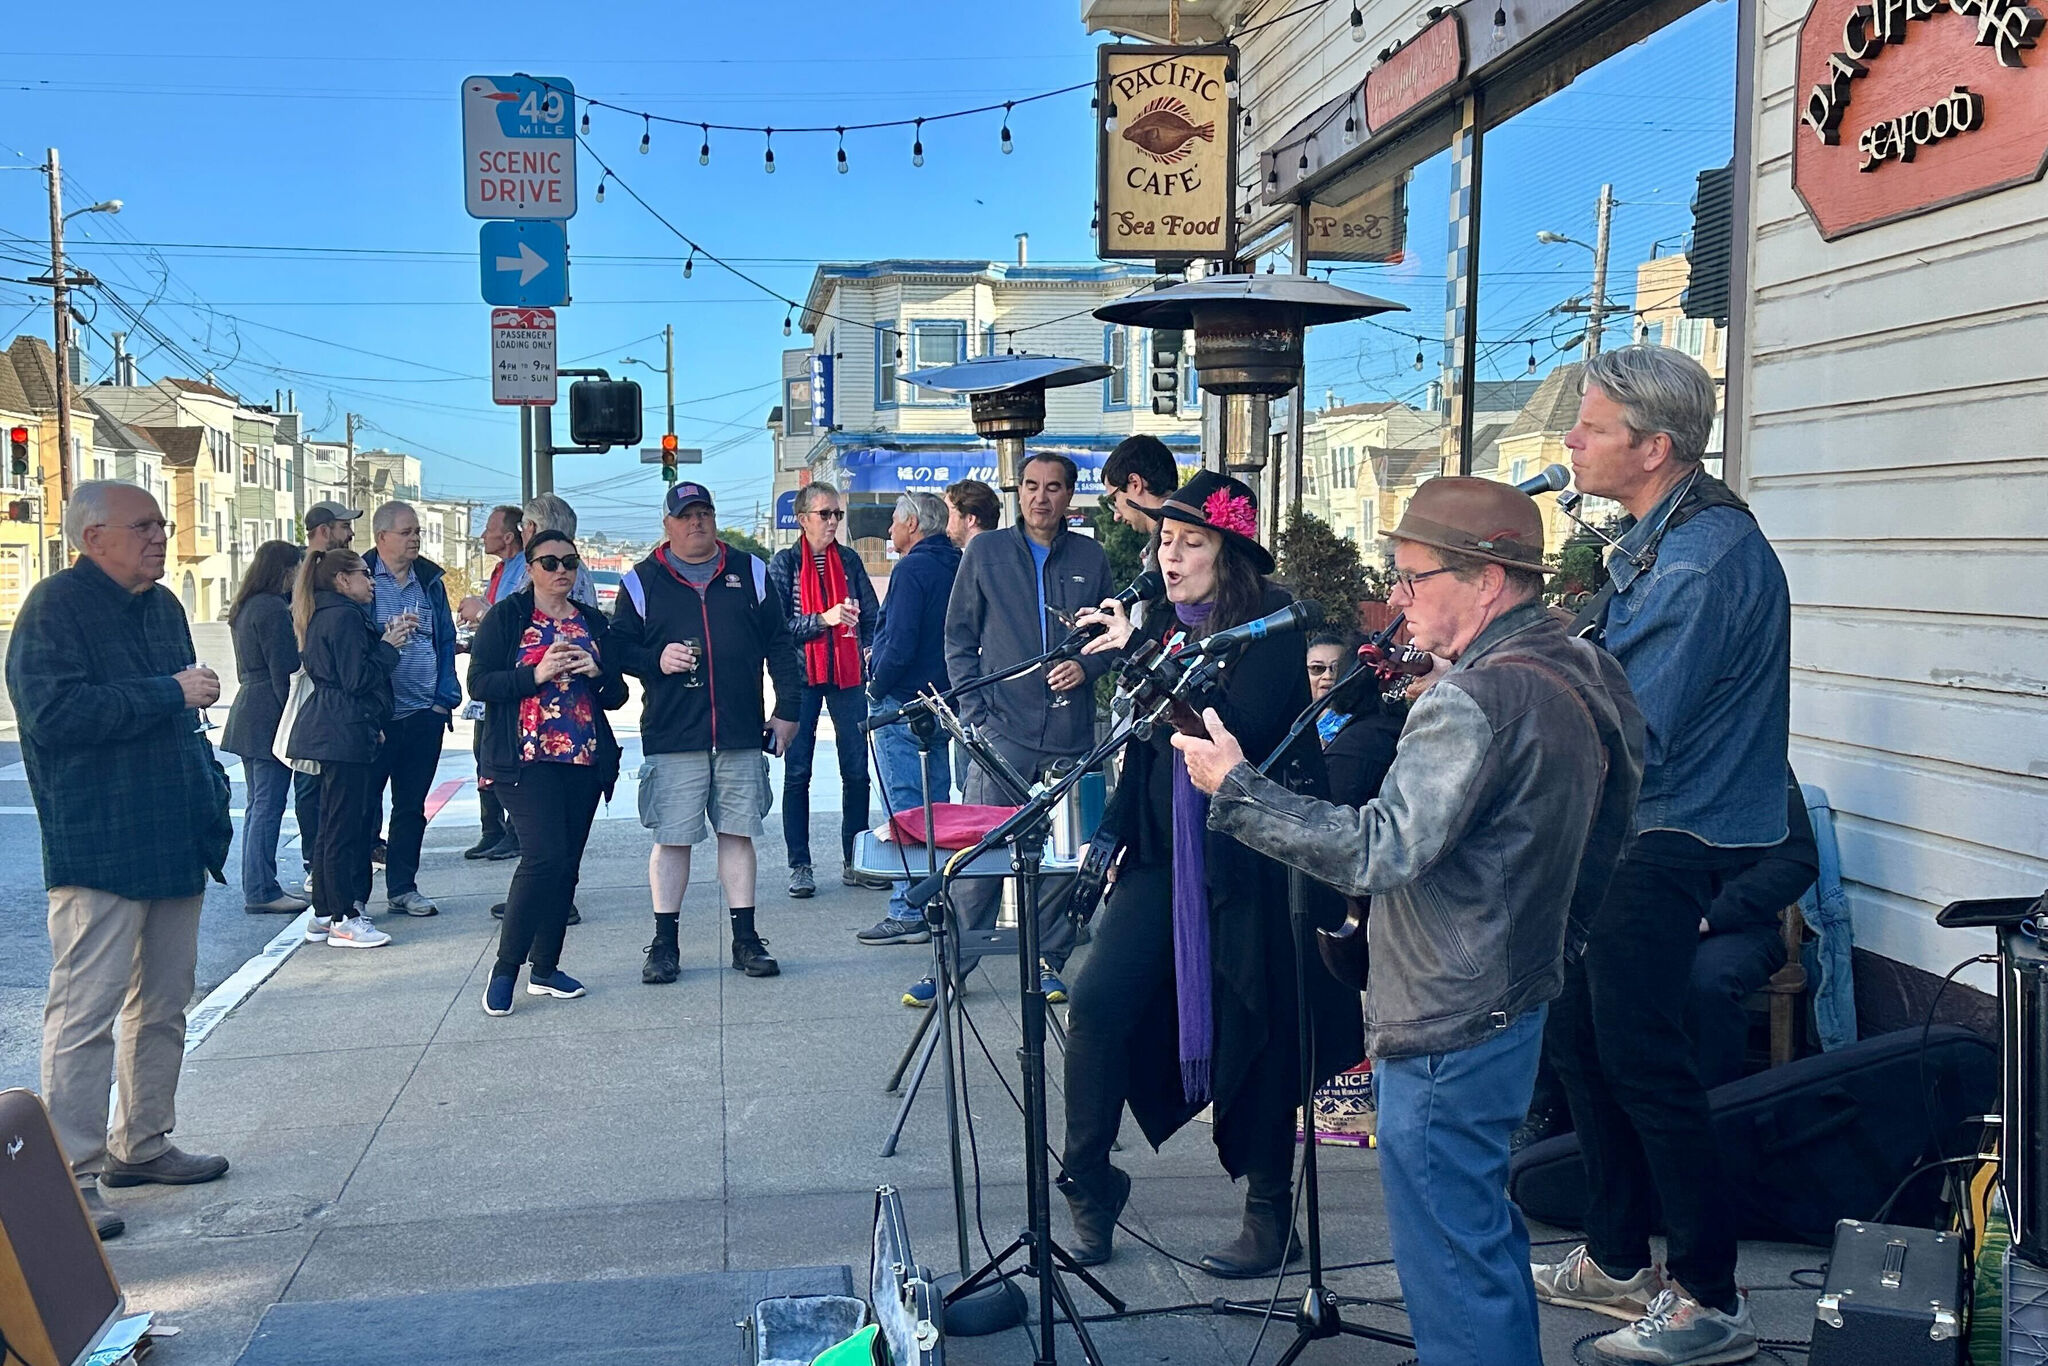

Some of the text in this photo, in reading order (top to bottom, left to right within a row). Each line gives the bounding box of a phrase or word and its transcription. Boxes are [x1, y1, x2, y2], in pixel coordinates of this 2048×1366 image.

[1115, 62, 1220, 102] PACIFIC
[518, 90, 565, 124] 49
[519, 125, 565, 135] MILE
[1858, 88, 1983, 173] SEAFOOD
[479, 150, 561, 174] SCENIC
[480, 178, 562, 203] DRIVE
[1111, 211, 1222, 237] Sea Food
[500, 330, 547, 339] PASSENGER
[495, 340, 553, 349] LOADING ONLY
[498, 359, 517, 371] 4PM
[532, 360, 551, 371] 9PM
[500, 373, 519, 382] WED
[531, 374, 549, 383] SUN
[1335, 1074, 1370, 1087] RICE
